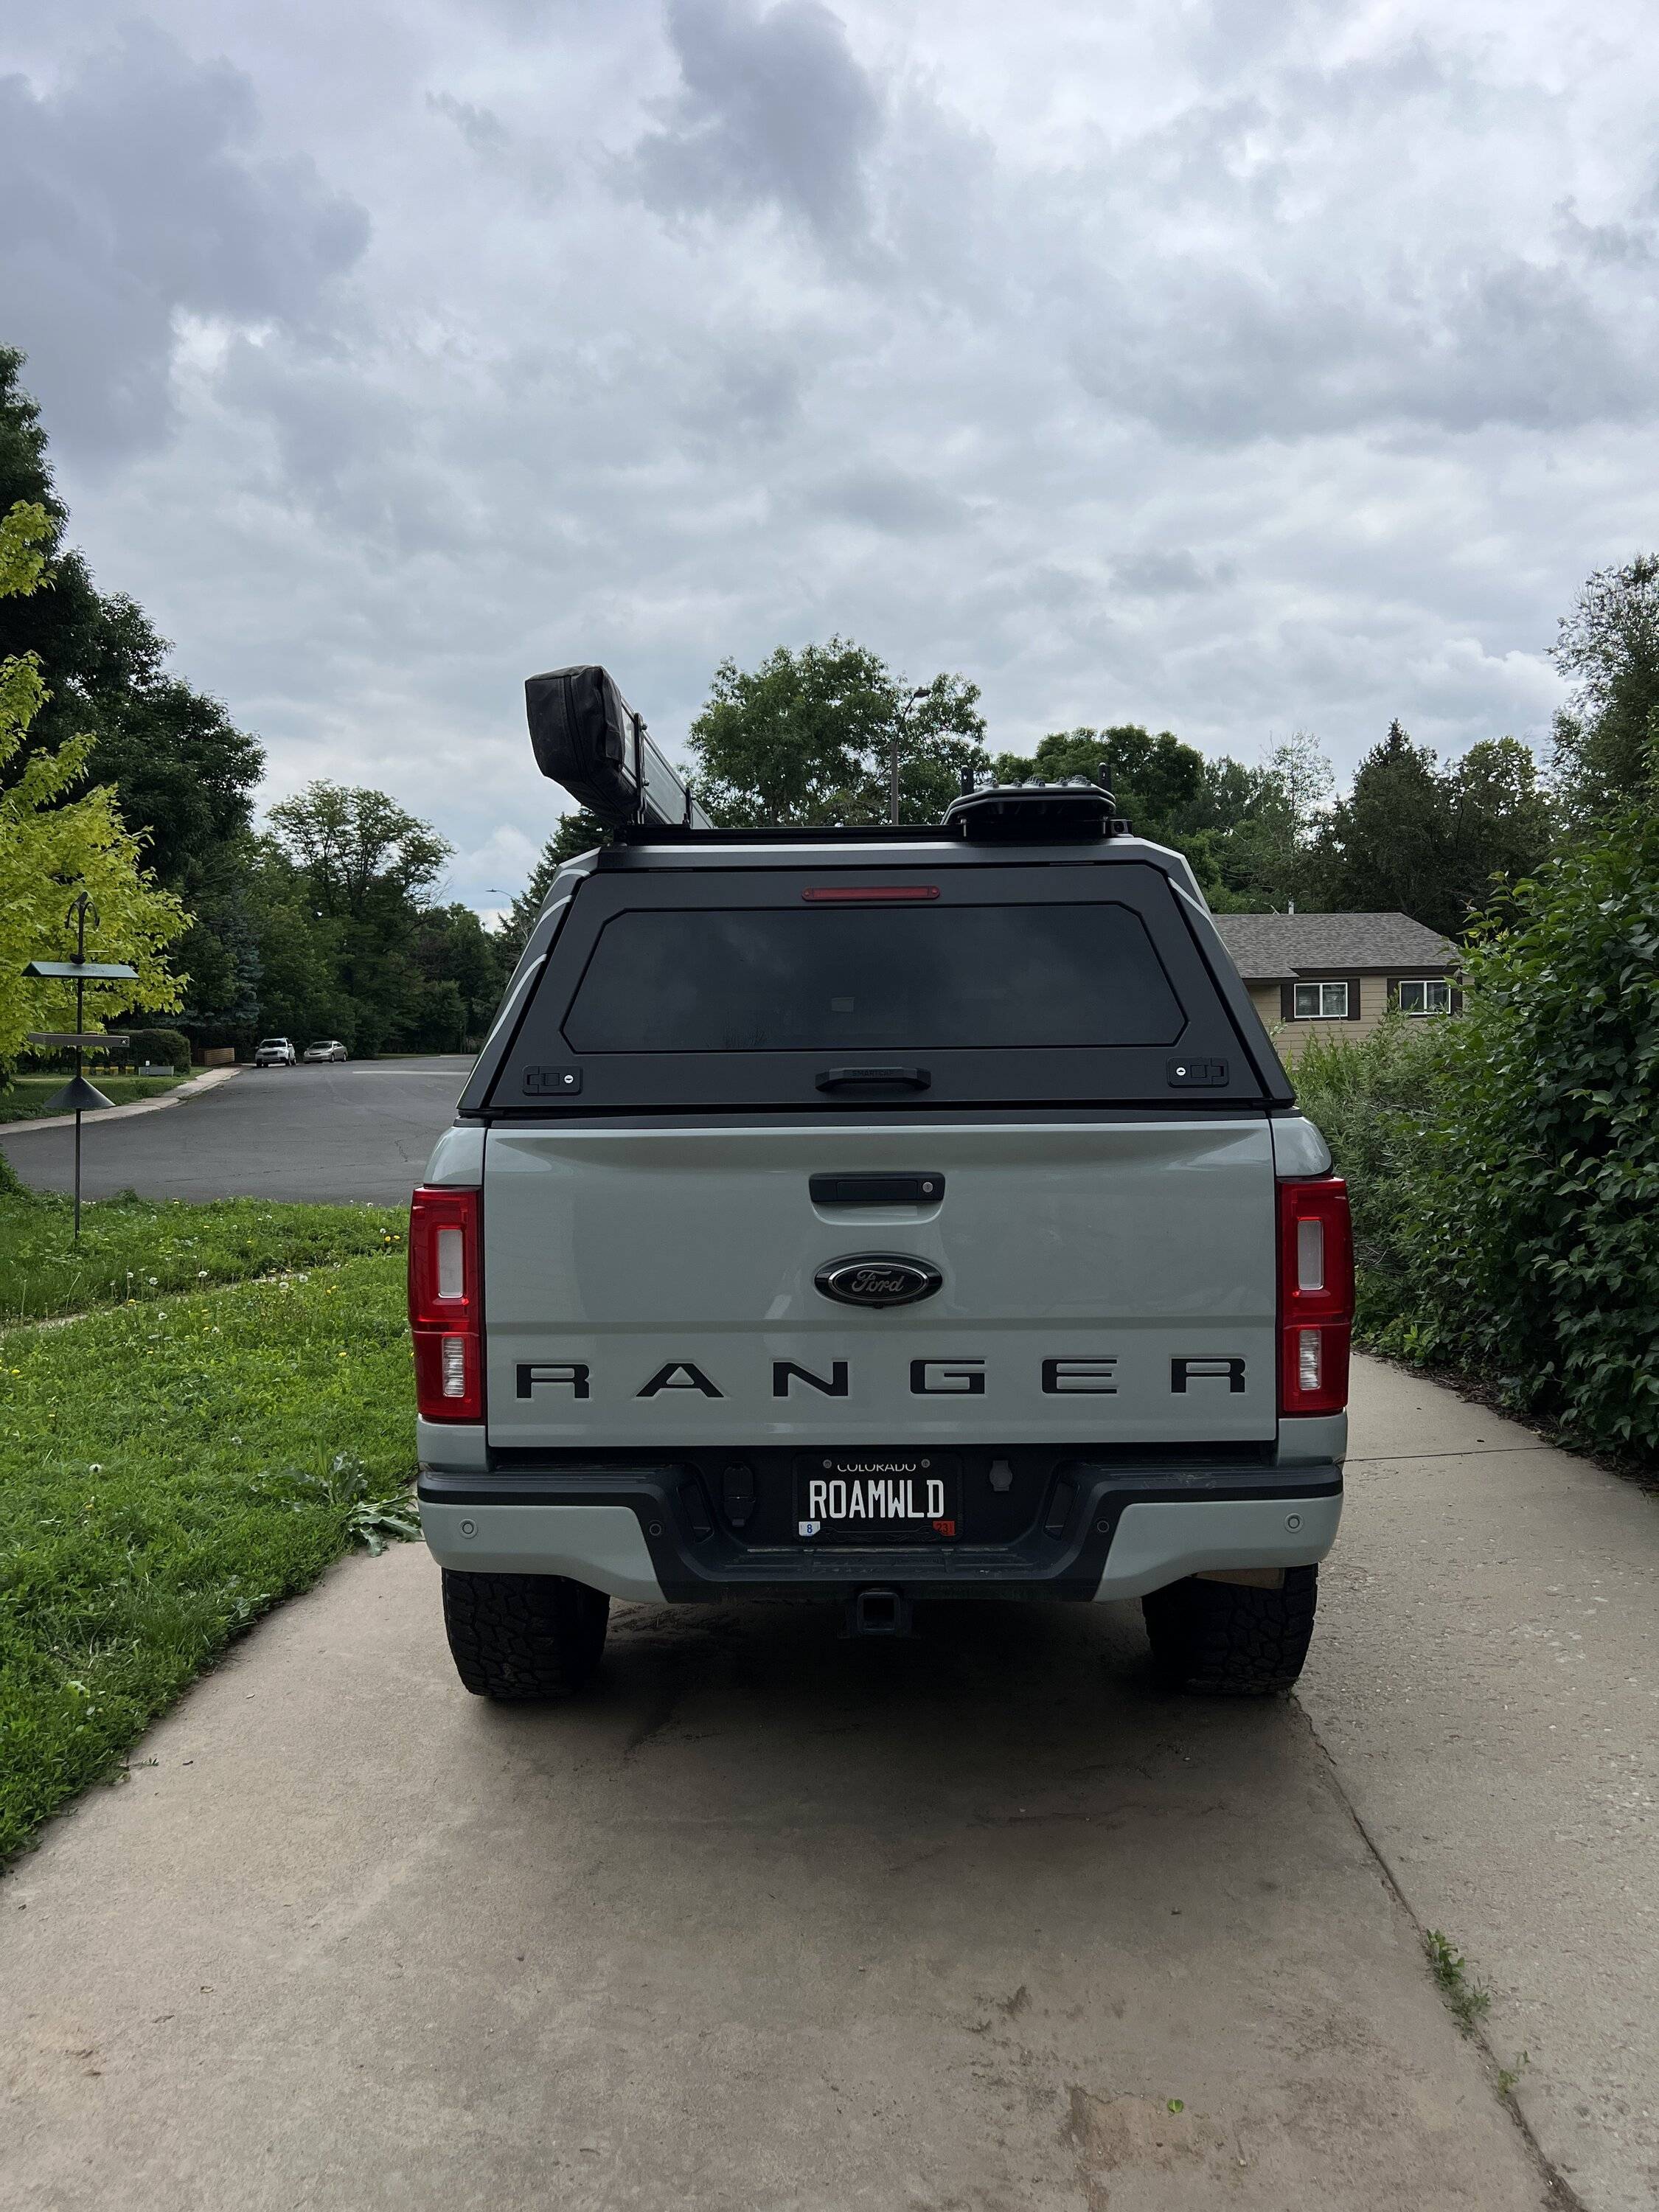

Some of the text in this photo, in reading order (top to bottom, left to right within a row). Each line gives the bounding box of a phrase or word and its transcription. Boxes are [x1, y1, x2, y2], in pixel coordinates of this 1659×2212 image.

[851, 1270, 905, 1293] Ford
[516, 1357, 1246, 1399] RANGER
[810, 1479, 945, 1519] ROAMWLD
[807, 1523, 813, 1534] 8
